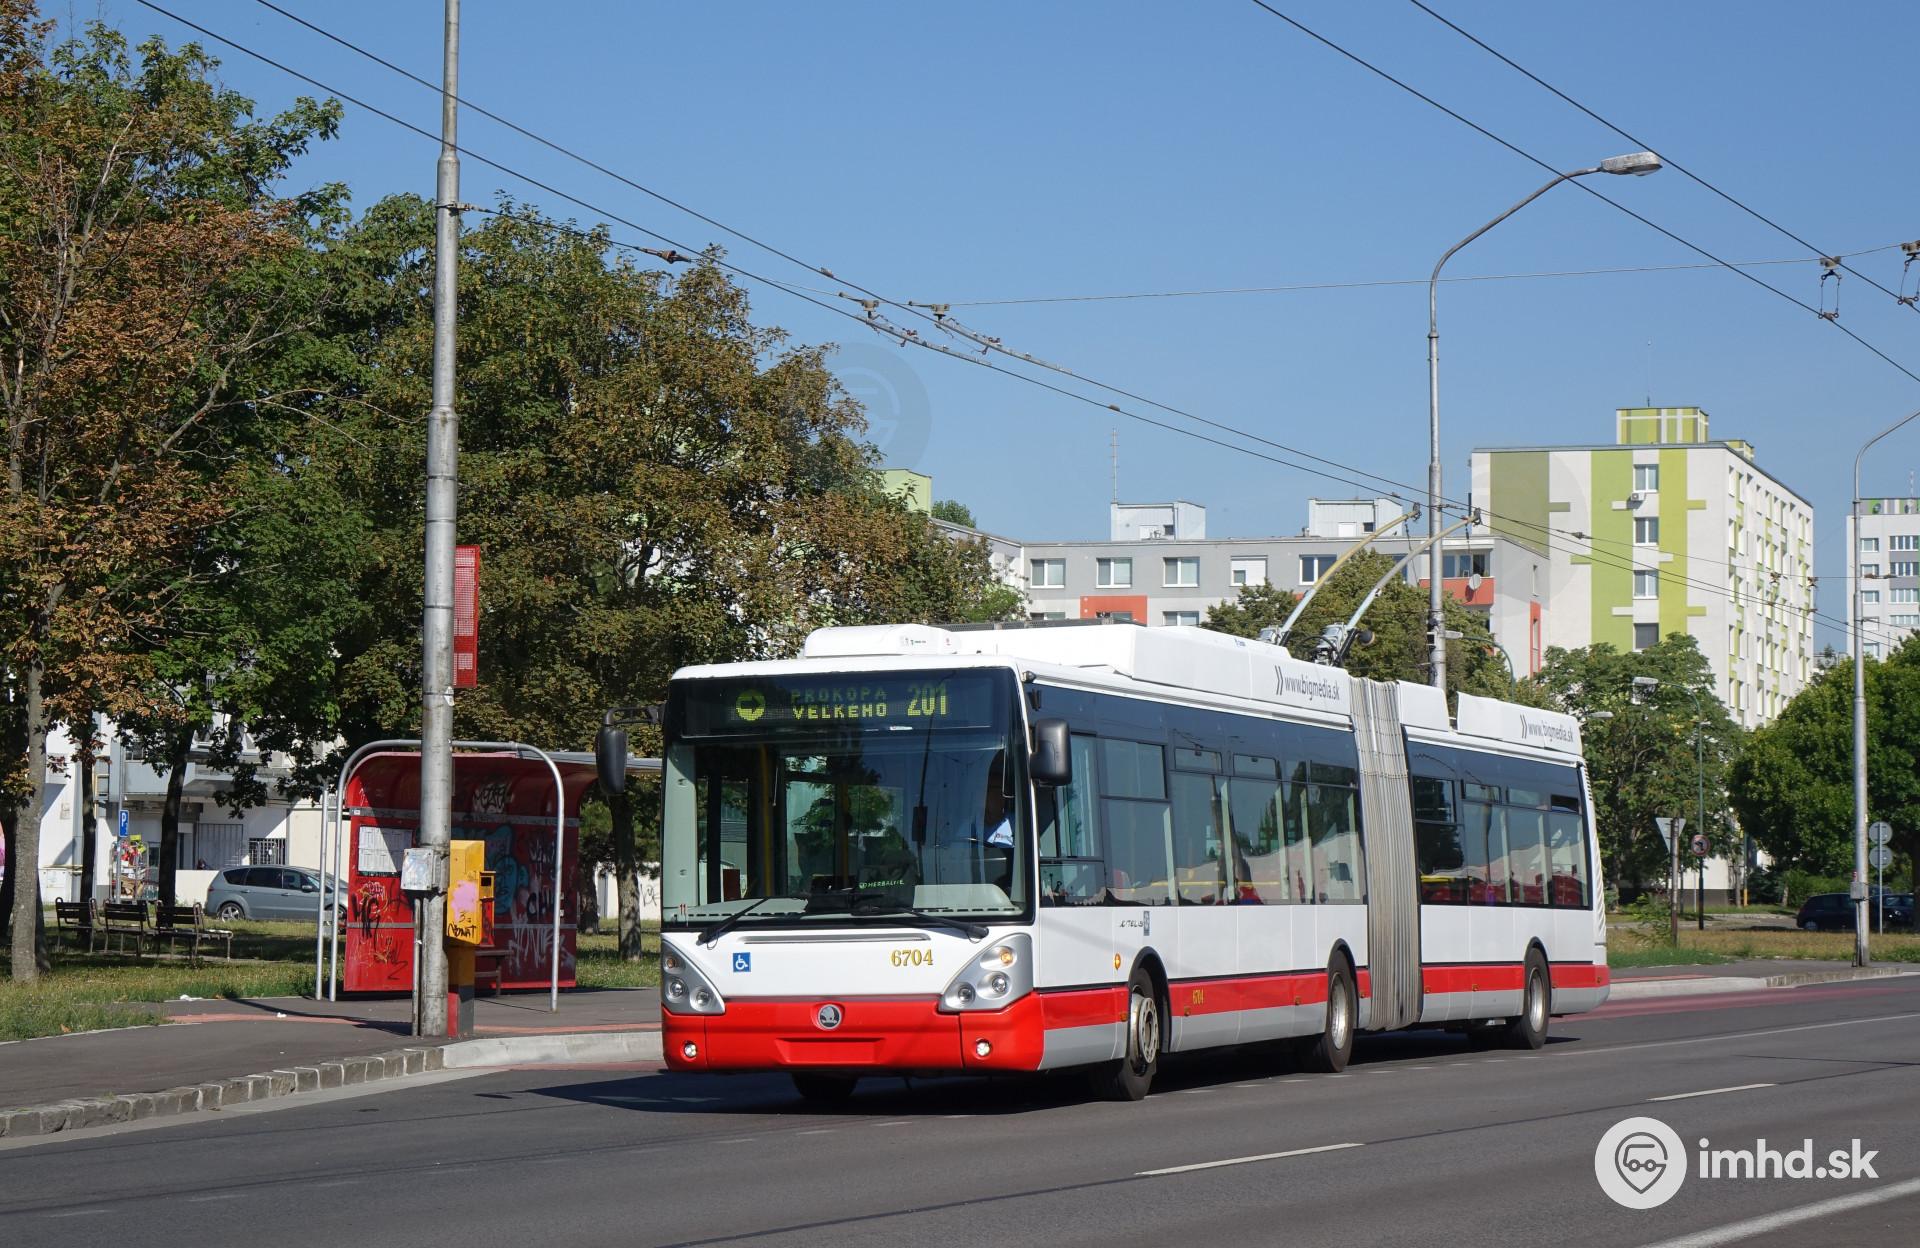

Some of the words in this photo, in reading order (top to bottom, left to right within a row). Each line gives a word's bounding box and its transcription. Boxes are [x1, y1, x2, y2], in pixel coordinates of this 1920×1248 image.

[791, 687, 888, 703] PROKOPA
[1285, 674, 1340, 701] www.bigmedia.sk
[907, 682, 948, 717] 201
[891, 949, 934, 967] 6704
